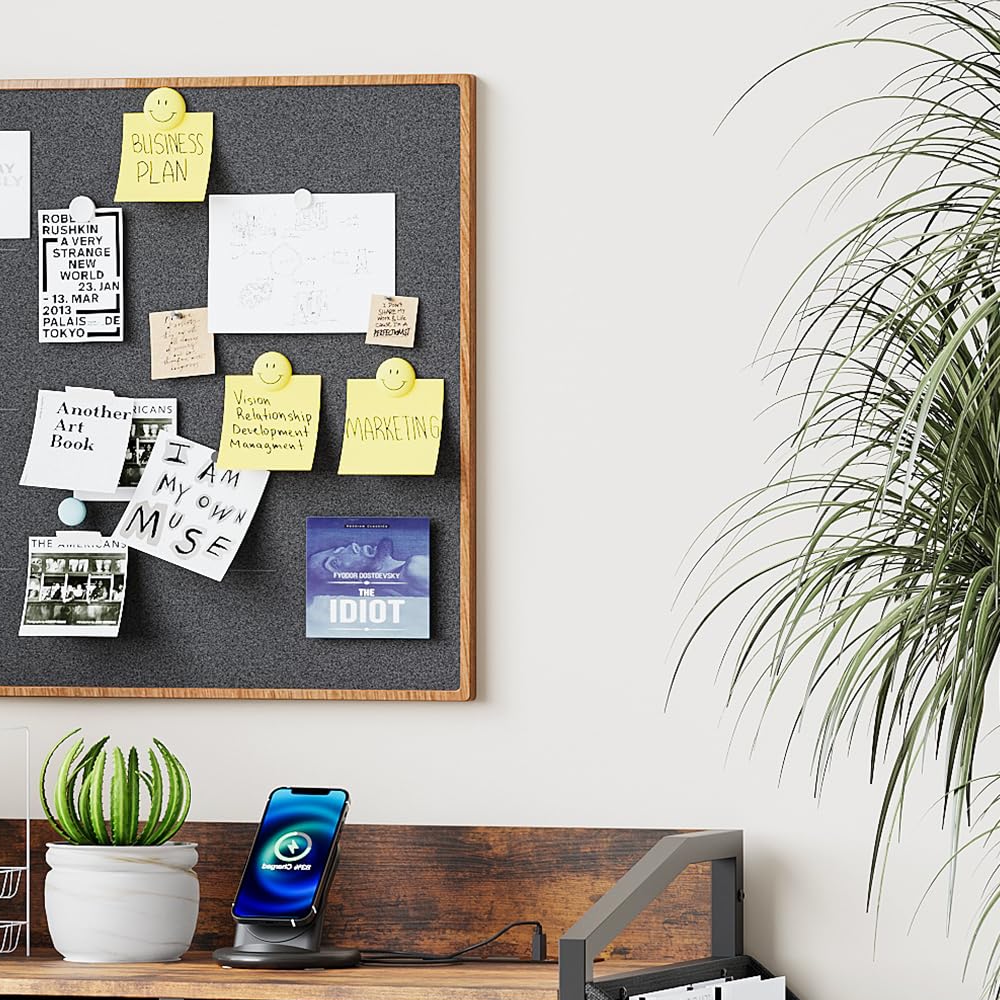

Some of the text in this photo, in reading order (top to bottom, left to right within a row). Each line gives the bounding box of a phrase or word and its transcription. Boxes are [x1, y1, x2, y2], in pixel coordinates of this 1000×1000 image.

[131, 133, 204, 155] BUSINESS
[136, 159, 188, 184] PLAN
[42, 225, 99, 235] RUSHKIN
[60, 236, 103, 246] A VERY
[53, 248, 111, 258] STRANGE
[68, 259, 96, 269] NEW
[60, 270, 104, 280] WORLD
[78, 282, 120, 291] 23. JAN
[51, 294, 68, 304] 13.
[71, 294, 99, 303] MAR
[42, 306, 72, 315] 2013
[43, 317, 87, 327] PALAIS
[105, 316, 121, 325] DE
[42, 328, 85, 338] TOKYO
[233, 389, 271, 406] Vision
[56, 402, 132, 420] Another
[236, 407, 312, 426] Relationship
[54, 419, 84, 433] Art
[232, 423, 309, 441] Development
[345, 416, 440, 441] MARKETING
[50, 434, 95, 451] Book
[164, 442, 240, 487] I AM
[156, 474, 247, 523] MY OWN
[126, 506, 232, 556] MUSE
[31, 540, 53, 548] THE
[358, 588, 375, 597] THE
[329, 599, 406, 624] IDIOT
